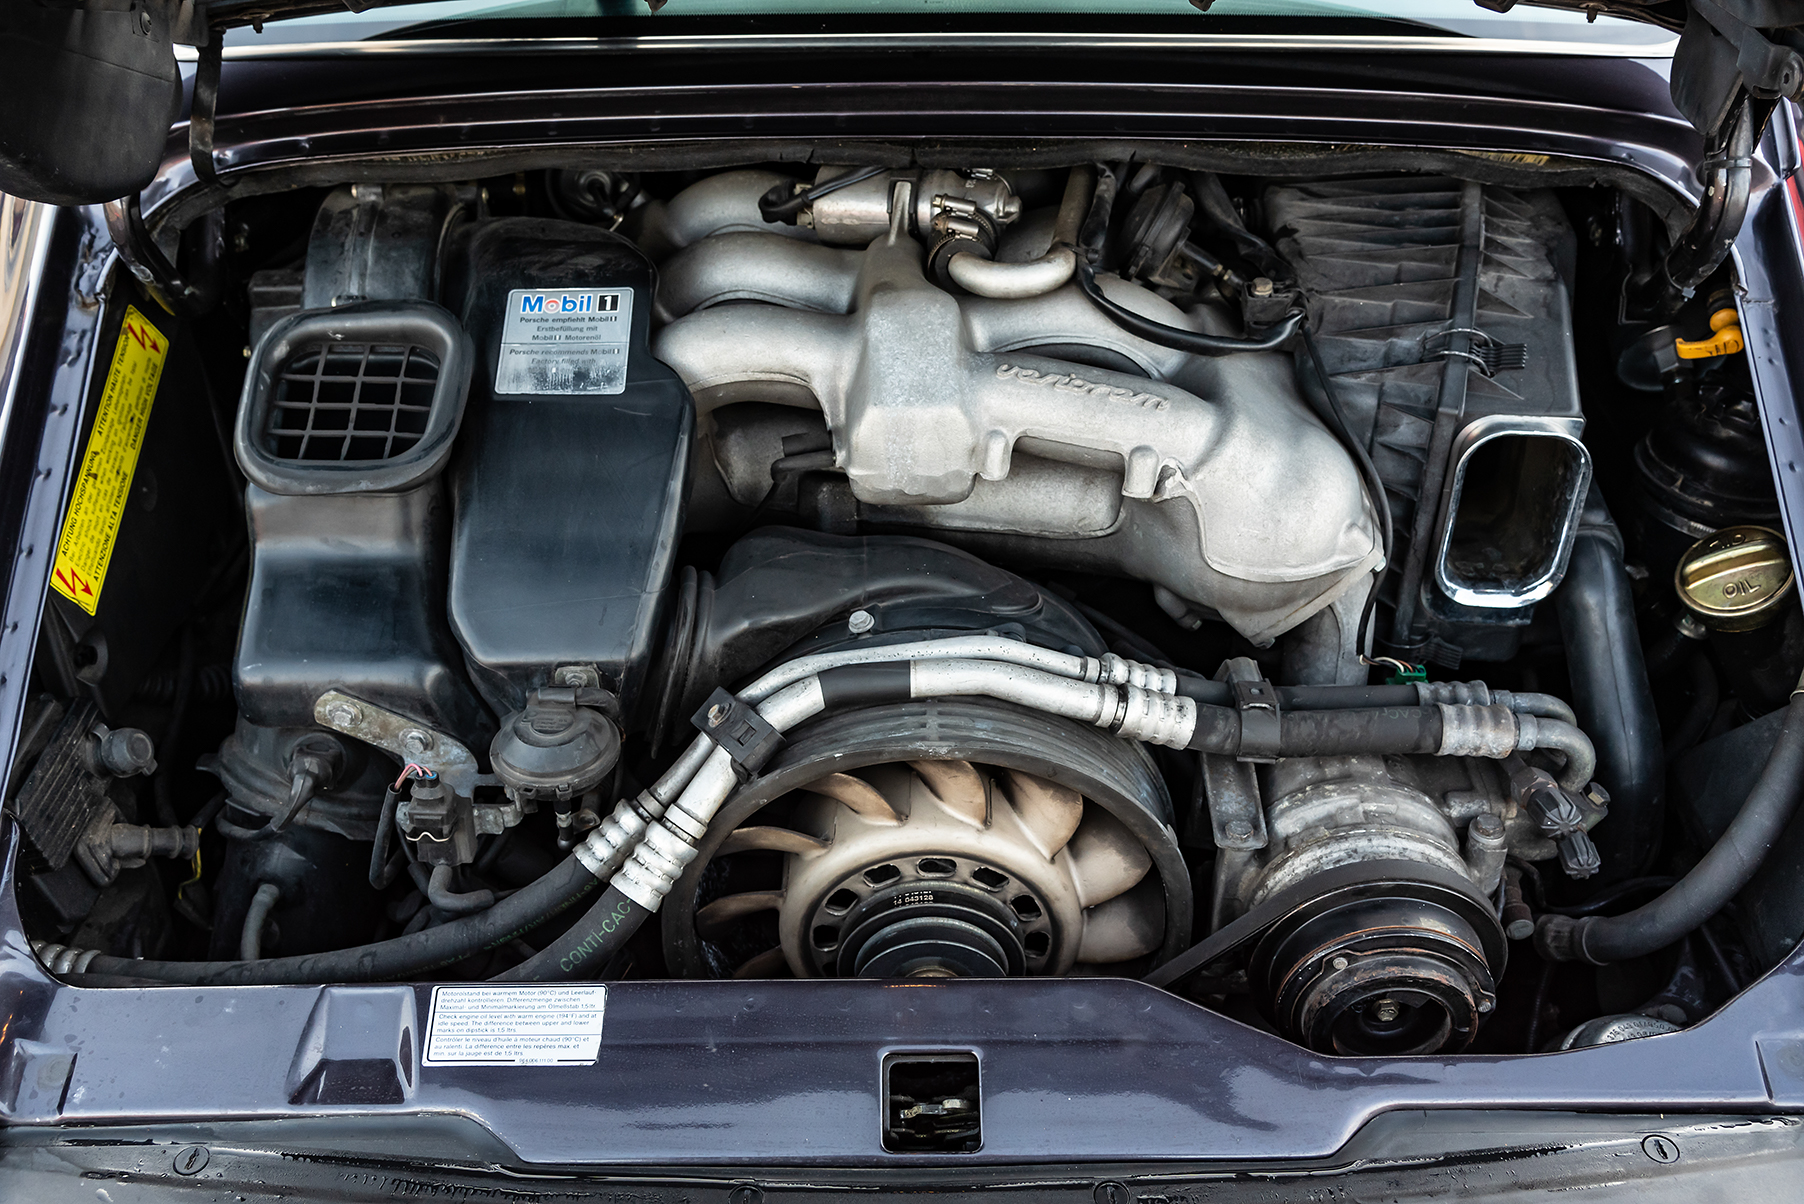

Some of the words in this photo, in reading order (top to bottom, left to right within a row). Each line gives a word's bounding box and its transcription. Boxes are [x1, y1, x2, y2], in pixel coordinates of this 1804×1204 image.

[522, 295, 592, 313] Mobil
[97, 392, 112, 436] ATTENTION
[109, 367, 120, 393] HAUTE
[130, 416, 142, 450] DANGER
[145, 361, 158, 397] VOLTAGE
[61, 515, 76, 557] ACHTUNG
[93, 531, 110, 582] ATTENZIONE
[107, 509, 116, 531] ALTA
[114, 470, 128, 509] TENSIONE
[1723, 580, 1761, 599] OIL
